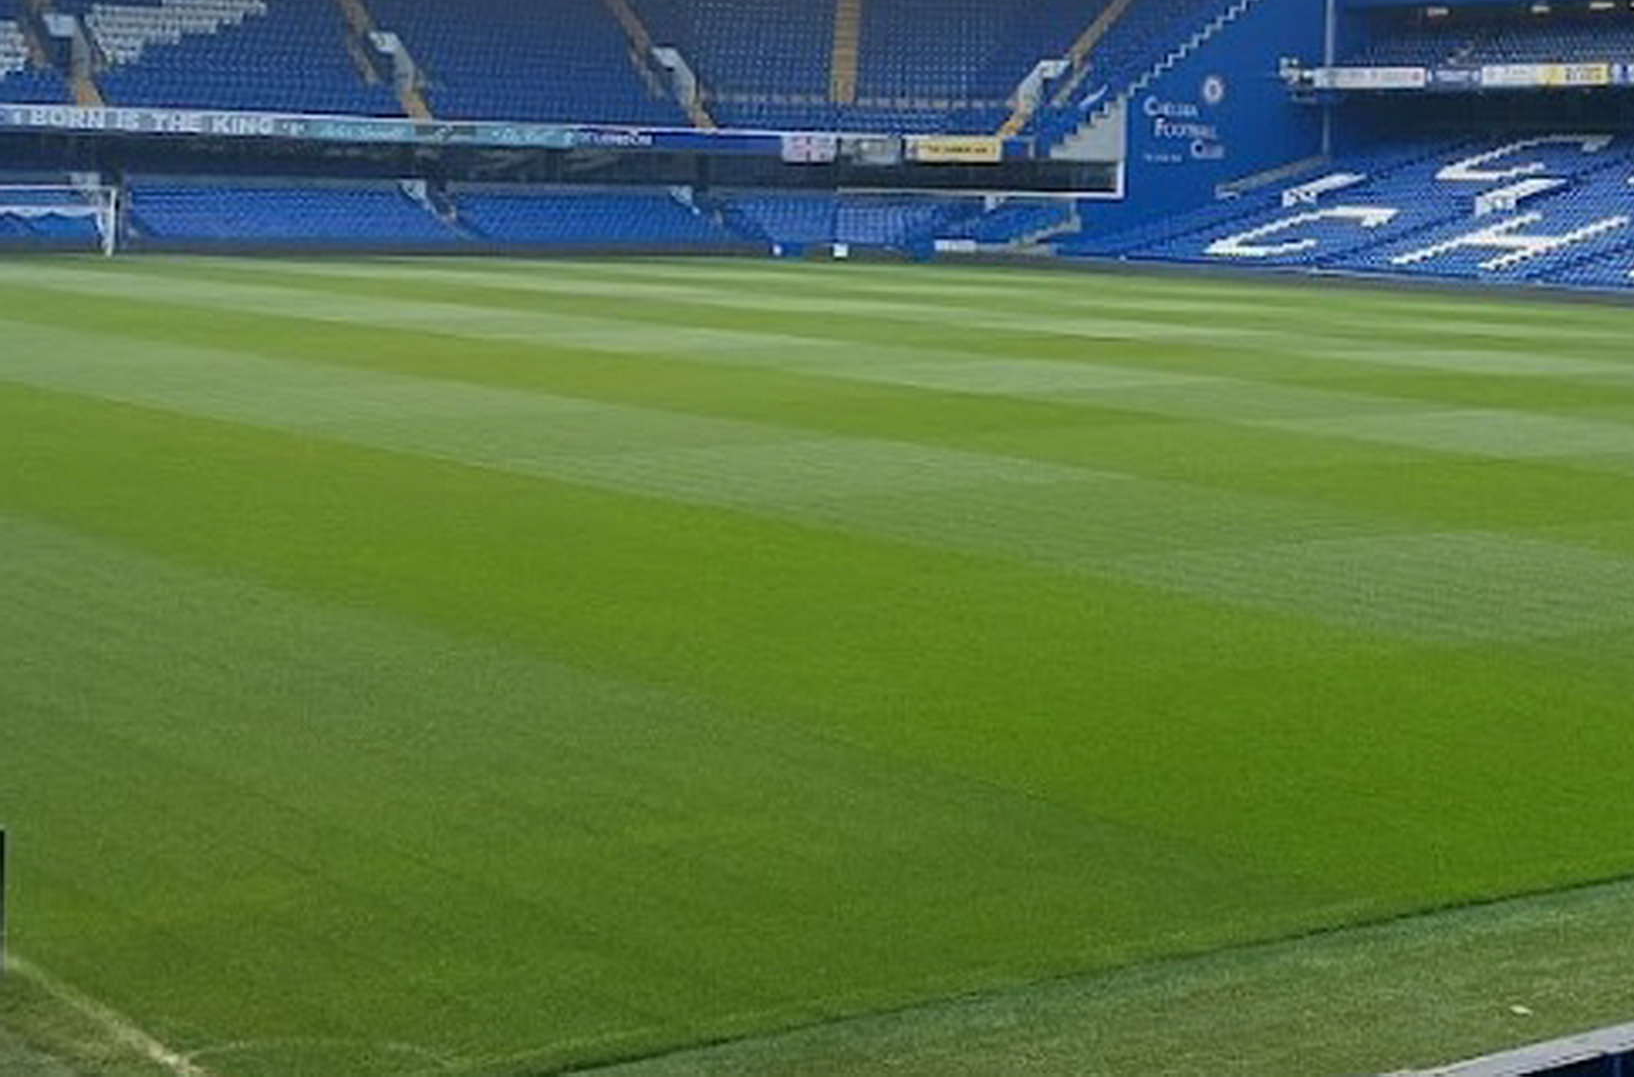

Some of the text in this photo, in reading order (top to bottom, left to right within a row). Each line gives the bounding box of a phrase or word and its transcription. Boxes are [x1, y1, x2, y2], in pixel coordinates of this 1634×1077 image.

[30, 109, 106, 129] BORN
[115, 111, 140, 130] IS
[152, 112, 202, 132] THE
[211, 115, 277, 135] KING
